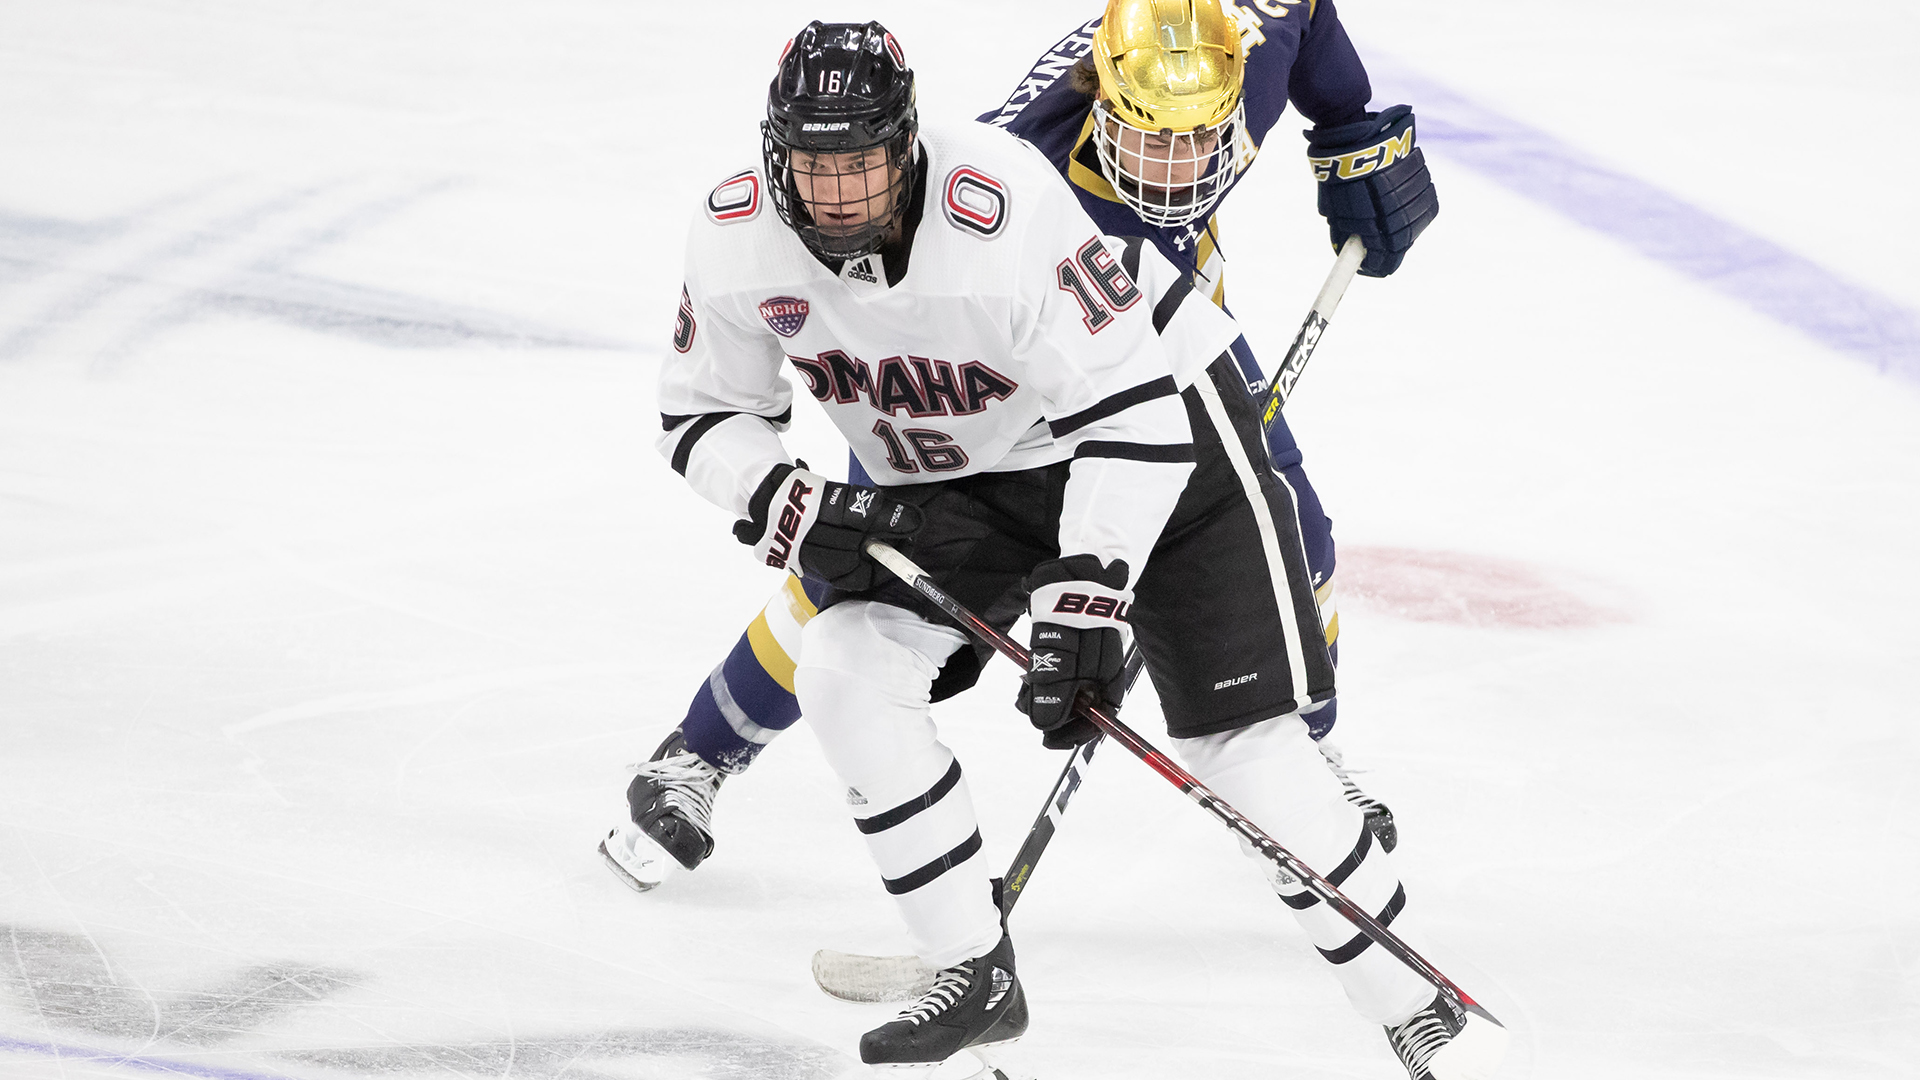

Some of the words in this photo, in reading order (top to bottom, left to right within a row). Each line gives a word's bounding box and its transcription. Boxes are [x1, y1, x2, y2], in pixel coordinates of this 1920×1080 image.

[818, 70, 841, 93] 16
[802, 122, 850, 132] BAUER
[1309, 126, 1413, 181] CCM
[847, 270, 878, 284] adidas
[1056, 234, 1143, 335] 16
[760, 302, 808, 318] NCHC
[787, 350, 1019, 418] OMAHA
[1275, 319, 1321, 402] TACKS
[872, 419, 969, 473] 16
[765, 478, 813, 570] AUER
[1214, 672, 1258, 690] BAUER
